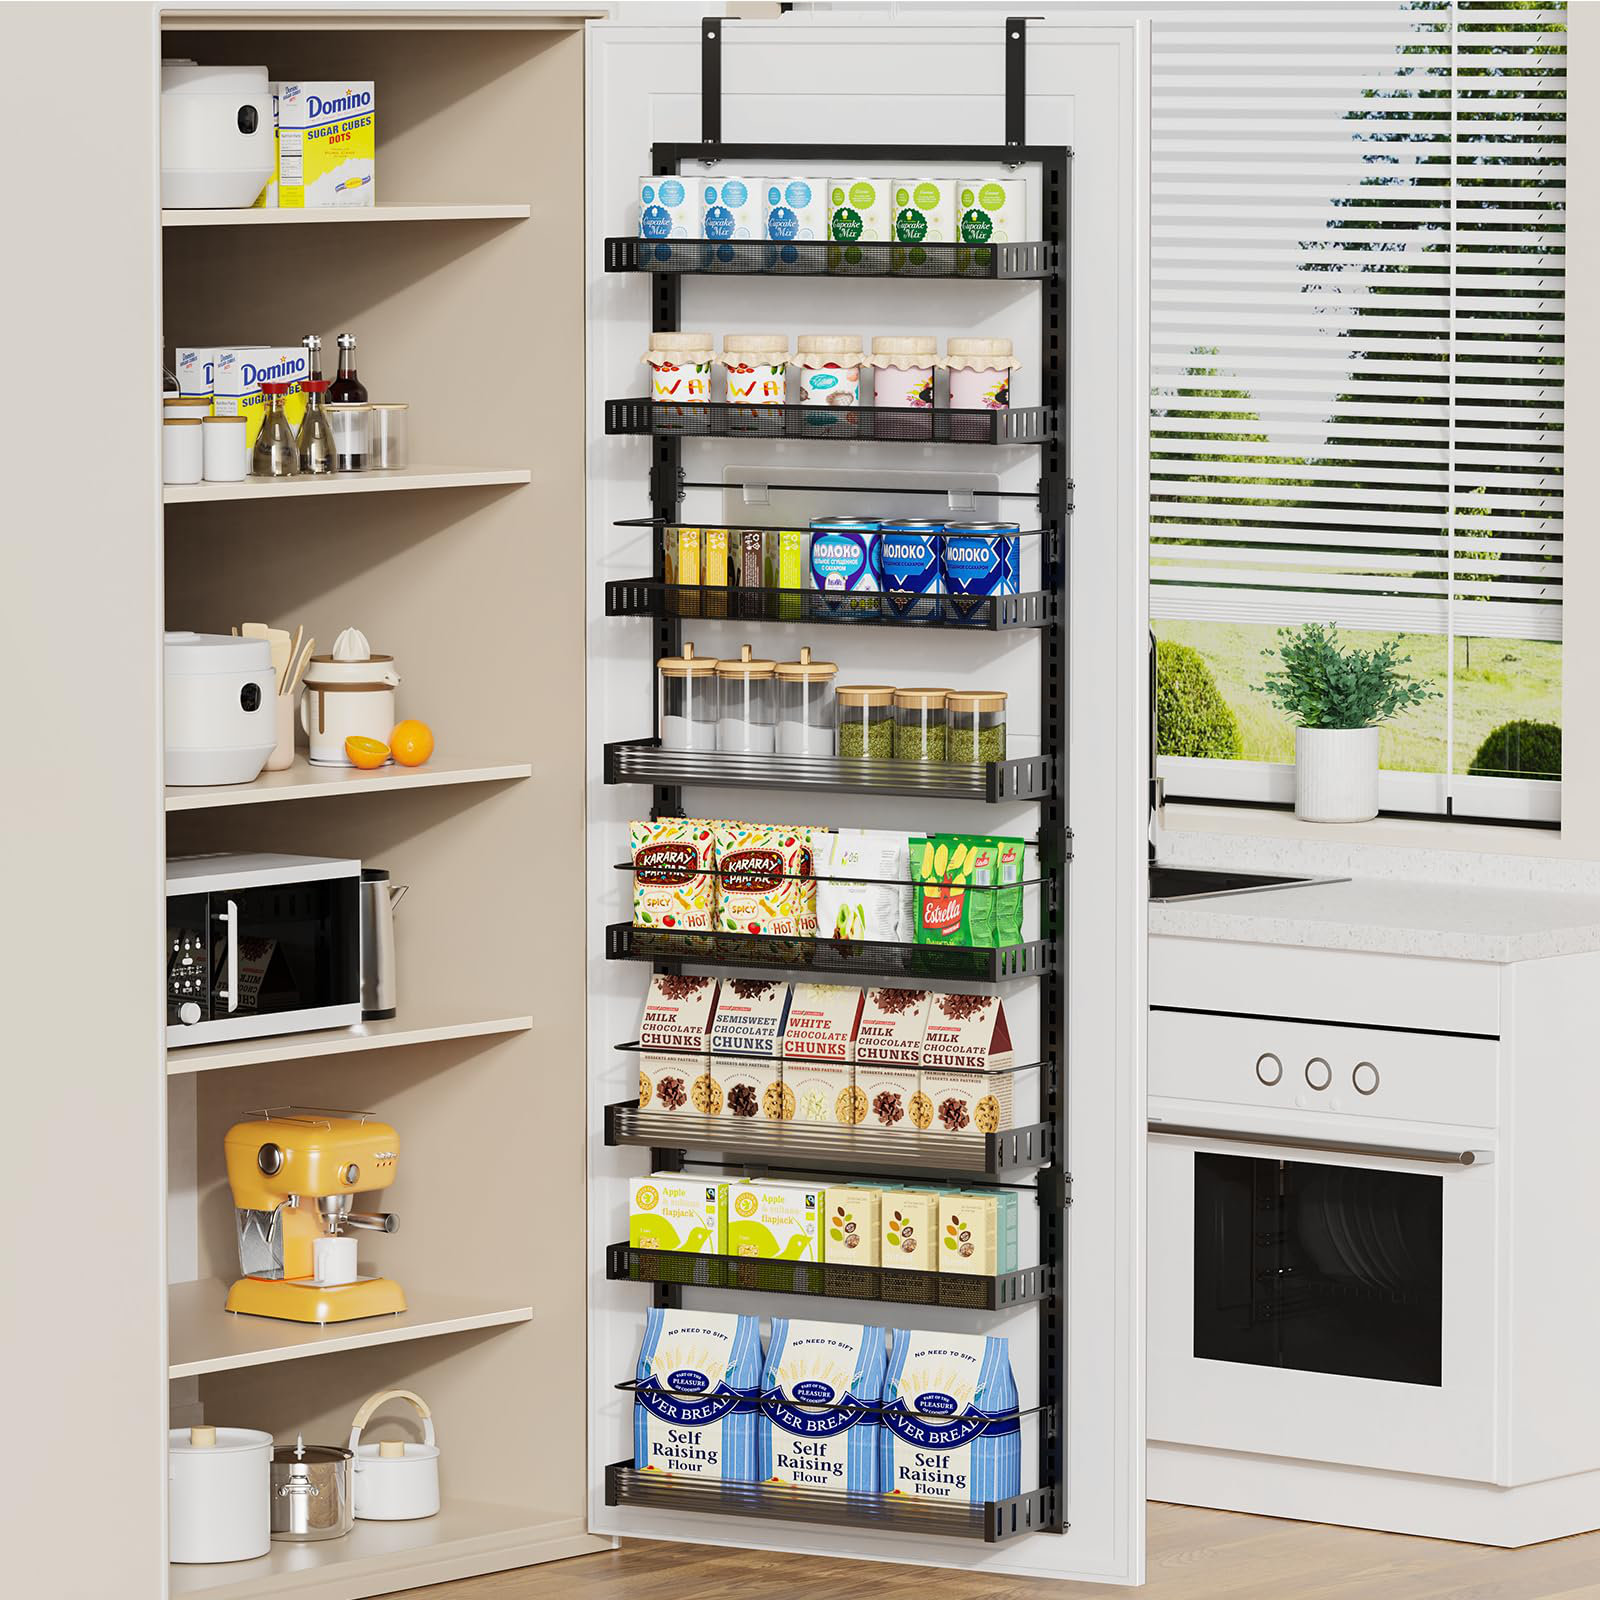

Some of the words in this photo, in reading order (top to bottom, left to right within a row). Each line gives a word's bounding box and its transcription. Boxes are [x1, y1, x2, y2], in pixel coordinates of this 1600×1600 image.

[306, 91, 371, 118] Domino
[307, 126, 339, 140] SUGAR
[342, 116, 372, 132] CUBES
[329, 132, 351, 144] DOTS
[643, 217, 671, 229] Cupcake
[705, 217, 733, 230] Cupcake
[769, 218, 797, 230] Cupcake
[832, 219, 860, 231] Cupcake
[897, 219, 925, 232] Cupcake
[962, 220, 991, 233] Cupcake
[649, 226, 667, 236] Mix
[712, 226, 730, 236] Mix
[775, 227, 793, 237] Mix
[839, 228, 857, 238] Mix
[903, 228, 922, 239] Mix
[969, 229, 988, 240] Mix
[241, 358, 305, 386] Domino
[655, 379, 711, 395] WA
[730, 381, 786, 396] WA
[814, 543, 860, 559] МОЛОКО
[643, 851, 692, 866] KARARAY
[729, 858, 778, 872] KARARAY
[647, 898, 671, 907] SPICY
[732, 905, 756, 914] SPICY
[925, 900, 961, 923] Estrella
[687, 914, 706, 927] HOT
[773, 922, 792, 935] HOT
[645, 1013, 677, 1022] MILK
[716, 1015, 777, 1025] SEMISWEET
[790, 1018, 832, 1029] WHITE
[642, 1024, 703, 1034] CHOCOLATE
[714, 1025, 775, 1036] CHOCOLATE
[860, 1027, 893, 1036] MILK
[641, 1033, 702, 1046] CHUNKS
[786, 1030, 848, 1041] CHOCOLATE
[926, 1033, 959, 1042] MILK
[712, 1036, 773, 1050] CHUNKS
[785, 1041, 846, 1055] CHUNKS
[858, 1038, 920, 1048] CHOCOLATE
[924, 1044, 986, 1054] CHOCOLATE
[857, 1047, 919, 1061] CHUNKS
[923, 1054, 985, 1067] CHUNKS
[662, 1187, 686, 1198] Apple
[761, 1194, 785, 1204] Apple
[662, 1208, 694, 1218] flapjack
[761, 1215, 793, 1225] flapjack
[713, 1331, 728, 1341] SIFT
[838, 1342, 854, 1352] SIFT
[961, 1352, 976, 1363] SIFT
[673, 1378, 705, 1386] PLEASURE
[797, 1389, 831, 1397] PLEASURE
[920, 1401, 954, 1409] PLEASURE
[668, 1430, 702, 1444] Self
[653, 1442, 718, 1464] Raising
[793, 1441, 827, 1457] Self
[668, 1459, 702, 1472] Flour
[777, 1454, 844, 1476] Raising
[915, 1453, 950, 1469] Self
[793, 1471, 828, 1484] Flour
[899, 1466, 966, 1489] Raising
[915, 1483, 950, 1496] Flour
